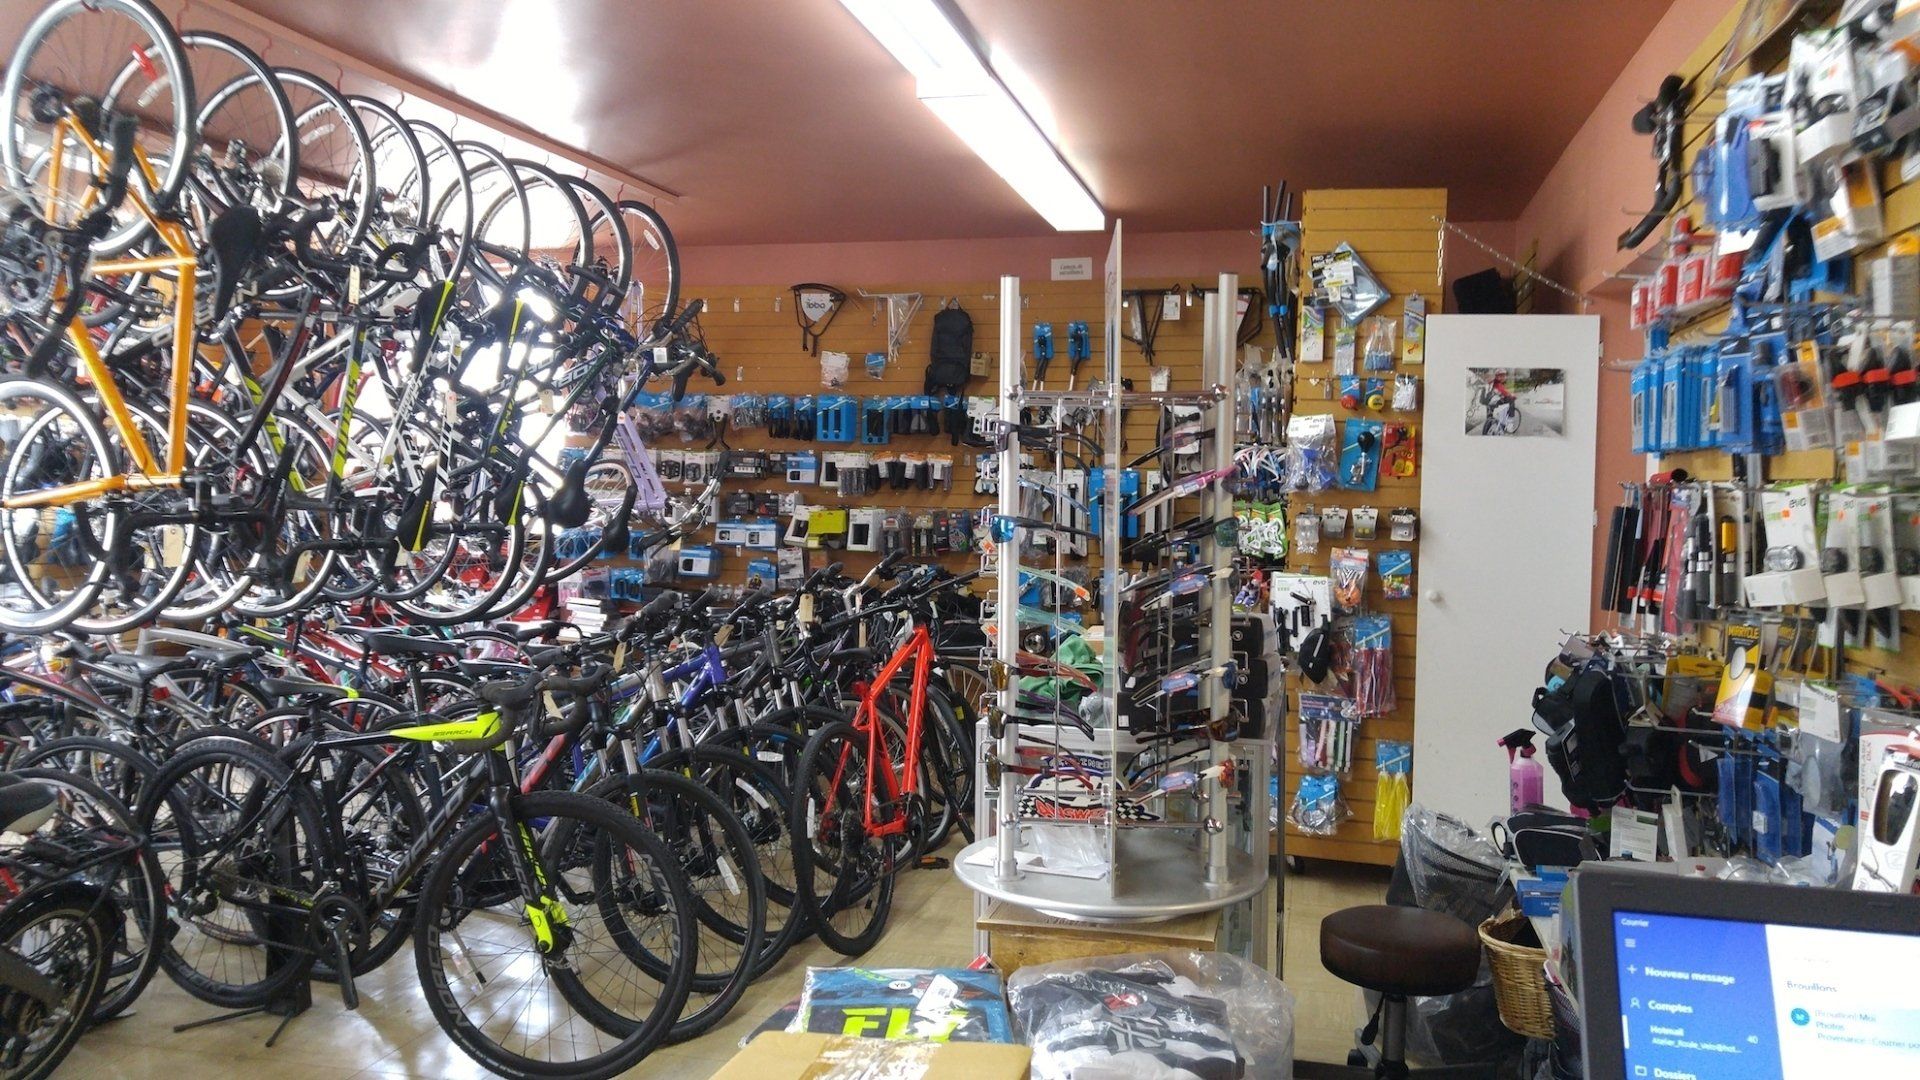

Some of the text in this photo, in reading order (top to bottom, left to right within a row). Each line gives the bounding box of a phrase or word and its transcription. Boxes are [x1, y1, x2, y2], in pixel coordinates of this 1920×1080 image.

[497, 816, 533, 901] NORCO
[1644, 966, 1735, 985] Nouveau message
[1786, 981, 1838, 993] Brouillons
[1648, 1000, 1693, 1014] Comptes
[1650, 1025, 1684, 1037] Hotmail
[1816, 1021, 1845, 1031] Photos
